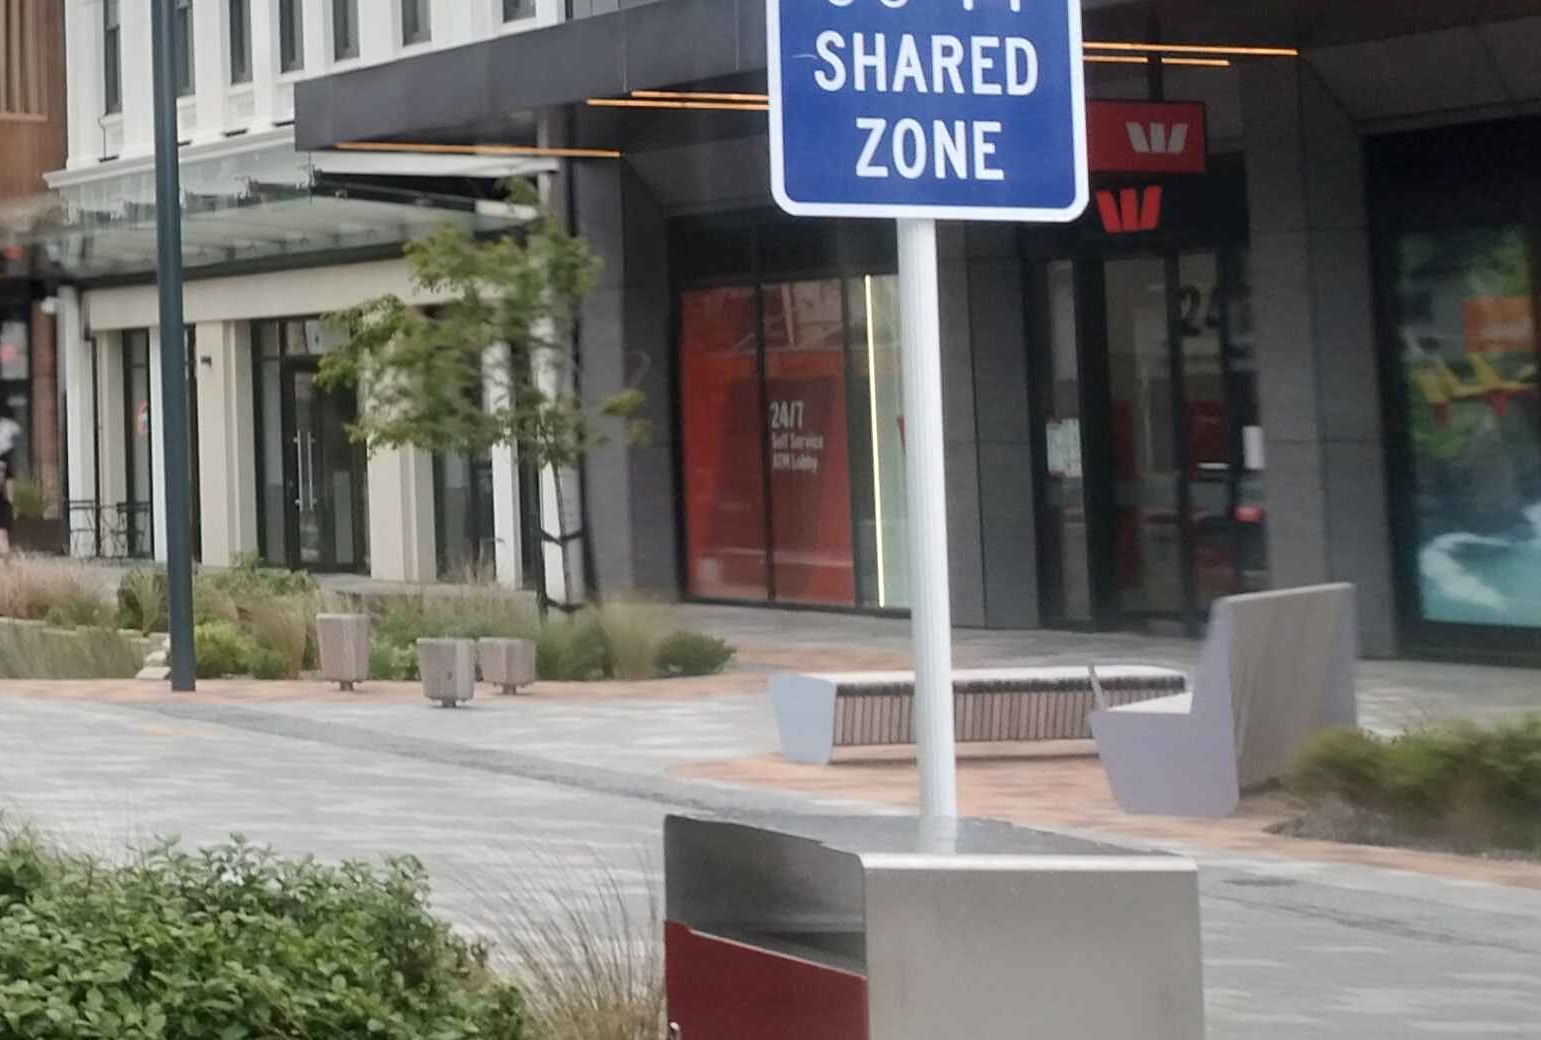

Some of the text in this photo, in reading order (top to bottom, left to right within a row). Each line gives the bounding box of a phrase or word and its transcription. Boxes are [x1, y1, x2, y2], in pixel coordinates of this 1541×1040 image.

[814, 30, 1038, 96] SHARED
[856, 117, 1005, 181] ZONE
[770, 400, 804, 429] 24/7
